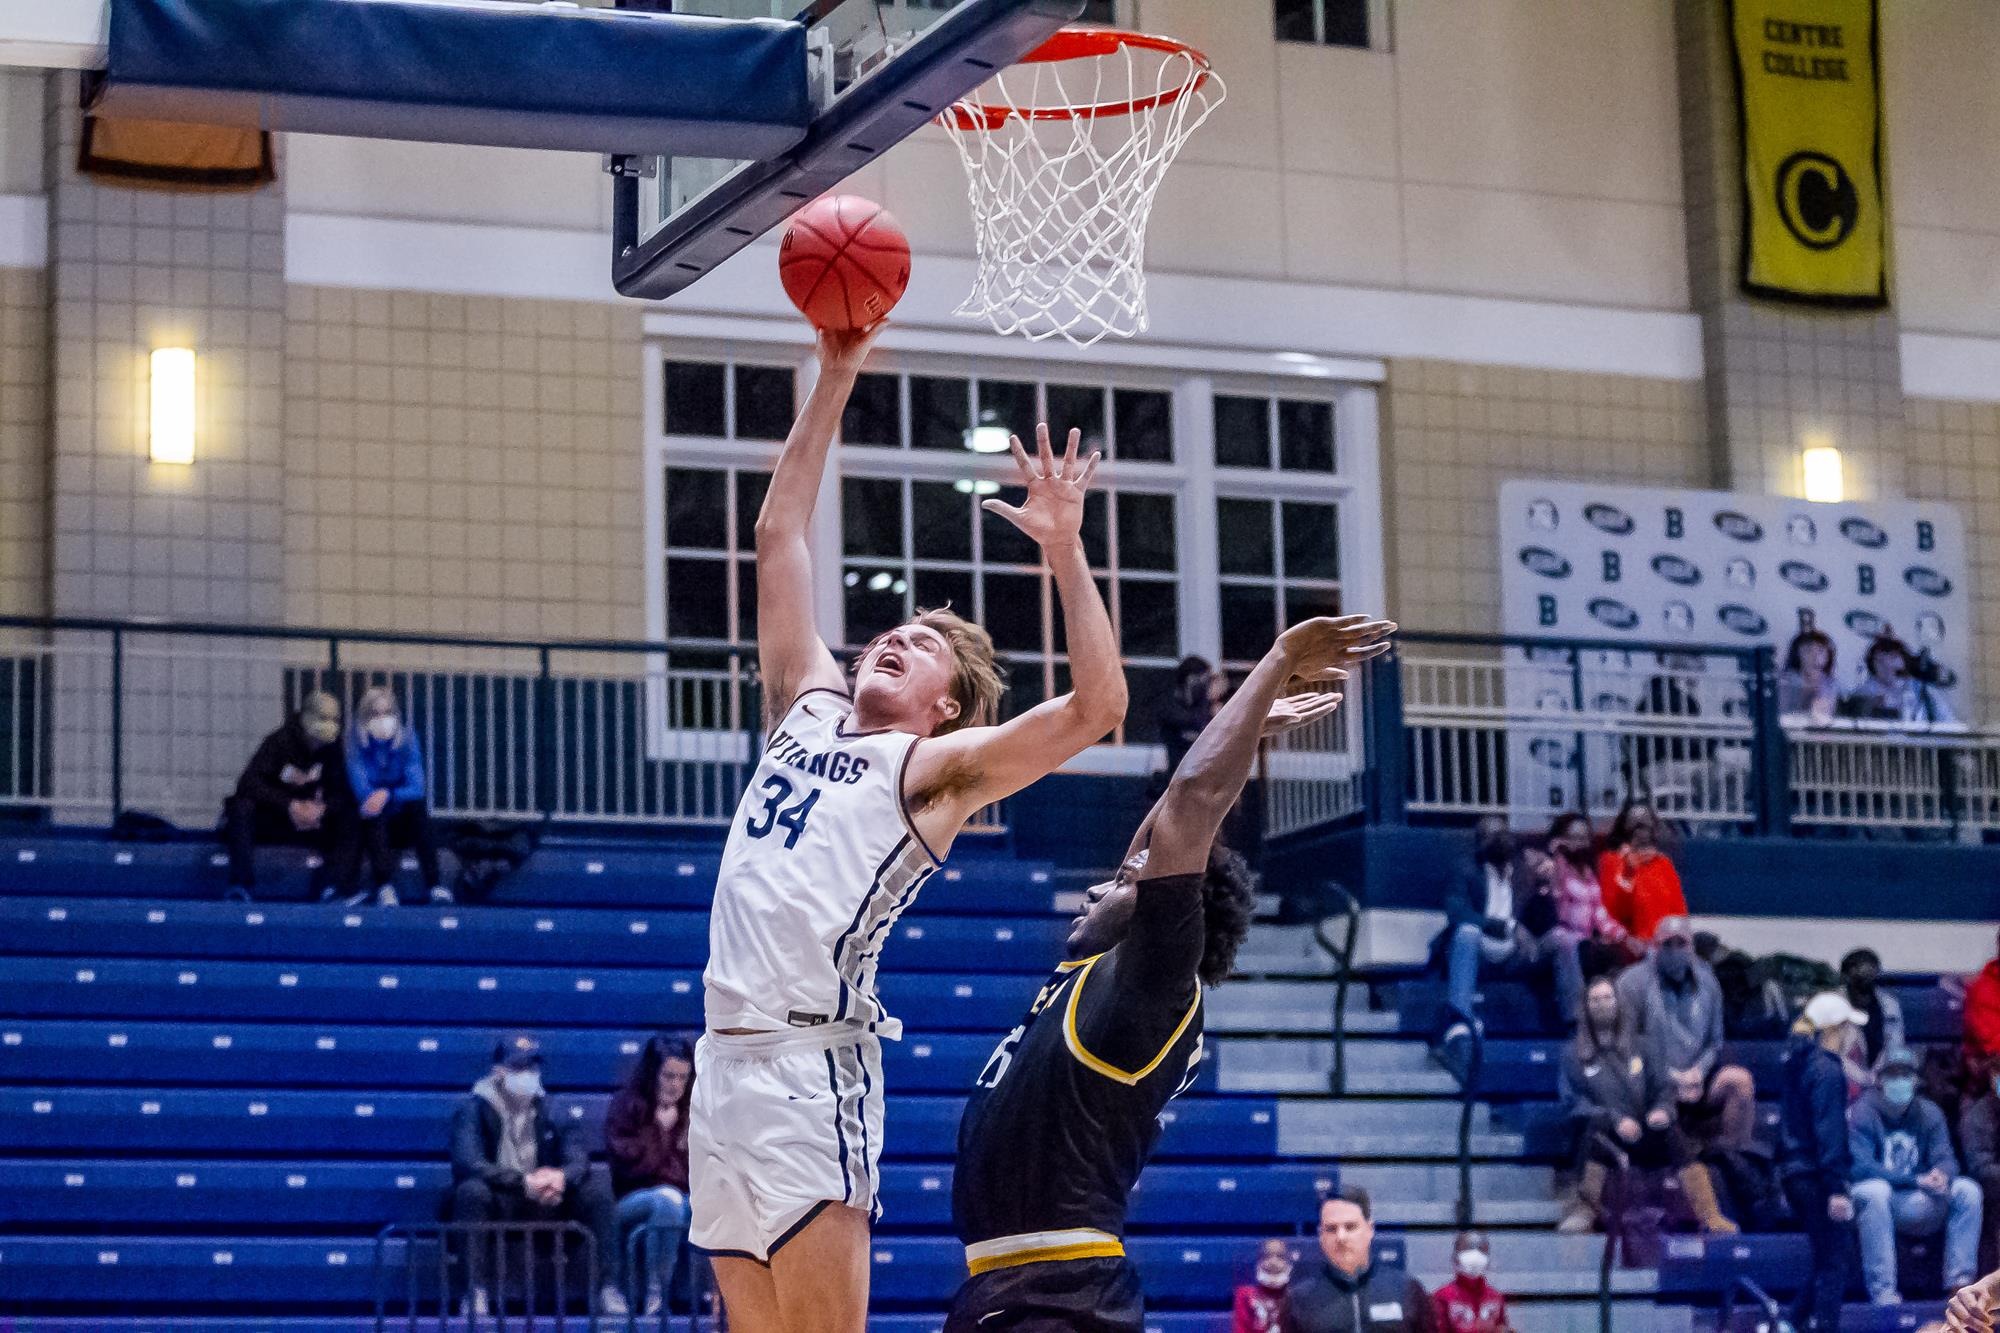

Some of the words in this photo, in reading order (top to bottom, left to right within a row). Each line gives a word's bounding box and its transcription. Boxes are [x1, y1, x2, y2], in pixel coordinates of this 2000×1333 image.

[1763, 18, 1844, 48] CENTRE
[1763, 51, 1849, 81] COLLEGE
[1779, 154, 1850, 247] C
[1665, 507, 1684, 539] B
[1916, 519, 1935, 552] B
[1602, 551, 1621, 582] B
[1857, 563, 1876, 595] B
[1538, 594, 1558, 626] B
[746, 773, 822, 851] 34
